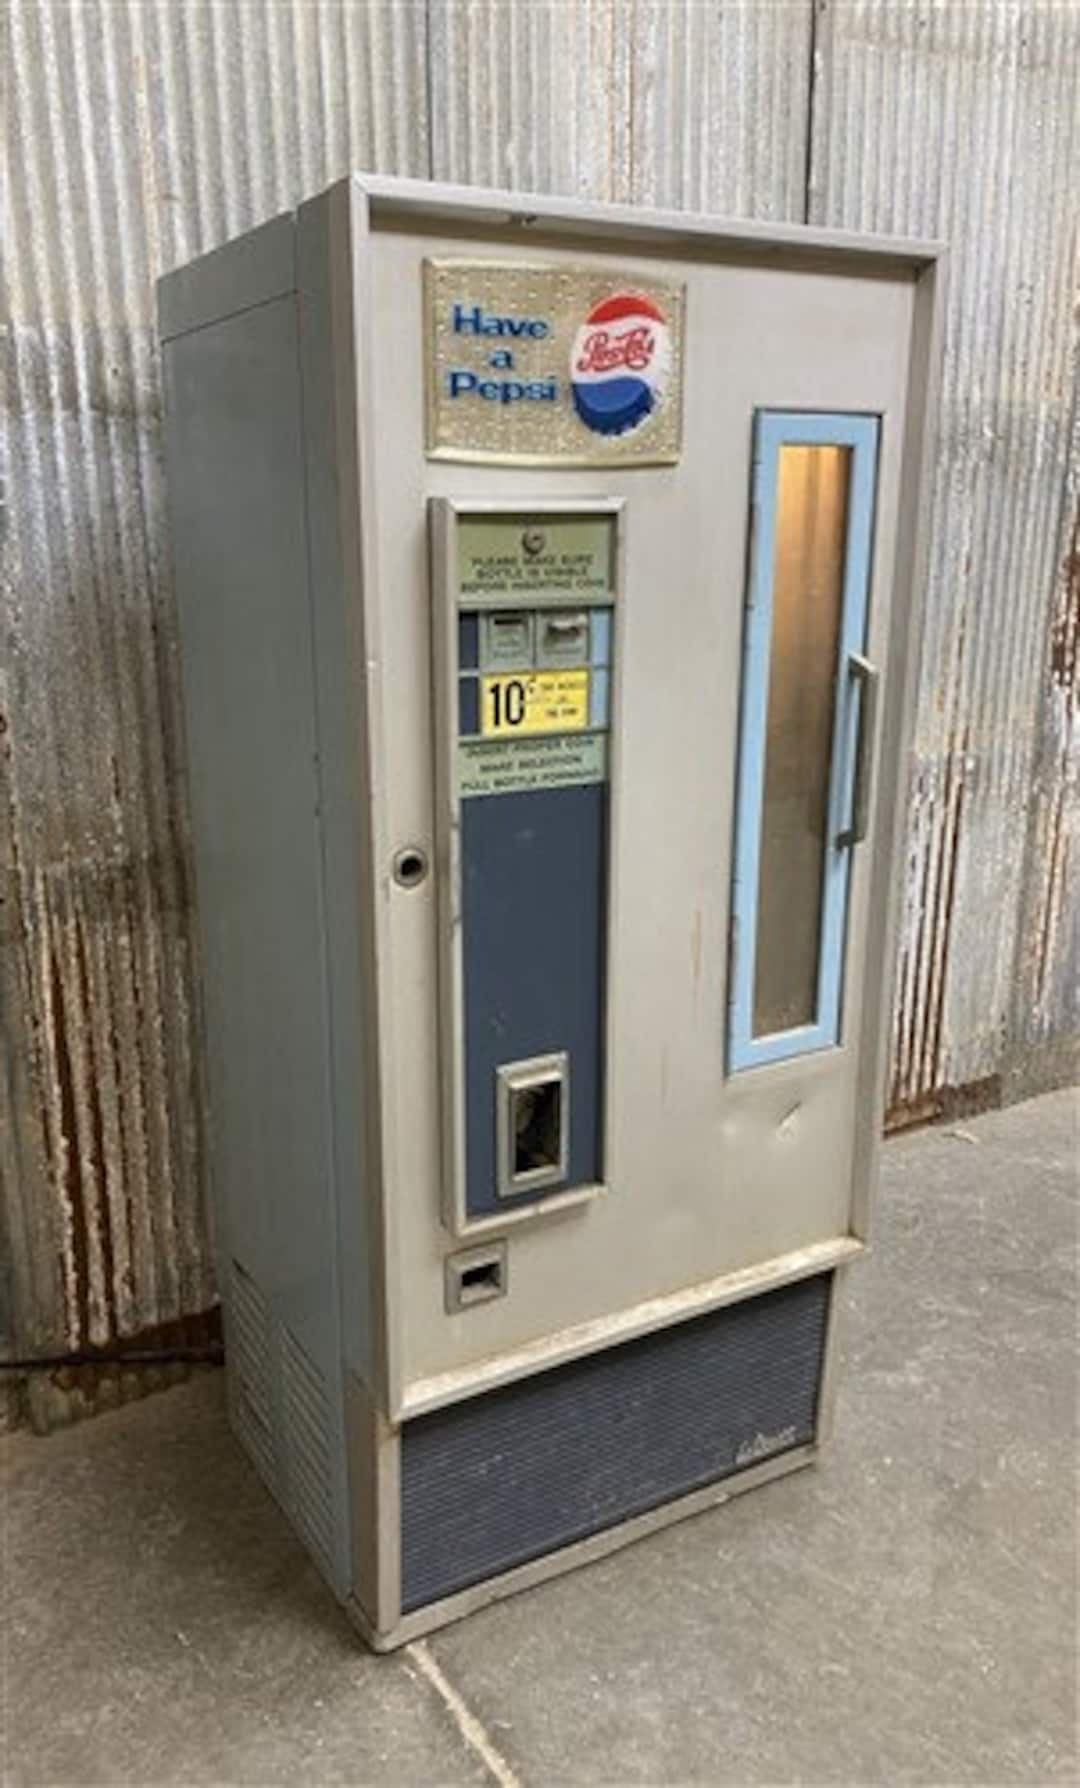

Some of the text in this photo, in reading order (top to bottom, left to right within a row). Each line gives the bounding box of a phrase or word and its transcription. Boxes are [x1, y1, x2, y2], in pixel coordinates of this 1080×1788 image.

[453, 304, 549, 340] Have
[489, 350, 513, 370] a
[449, 372, 557, 405] Pepsi
